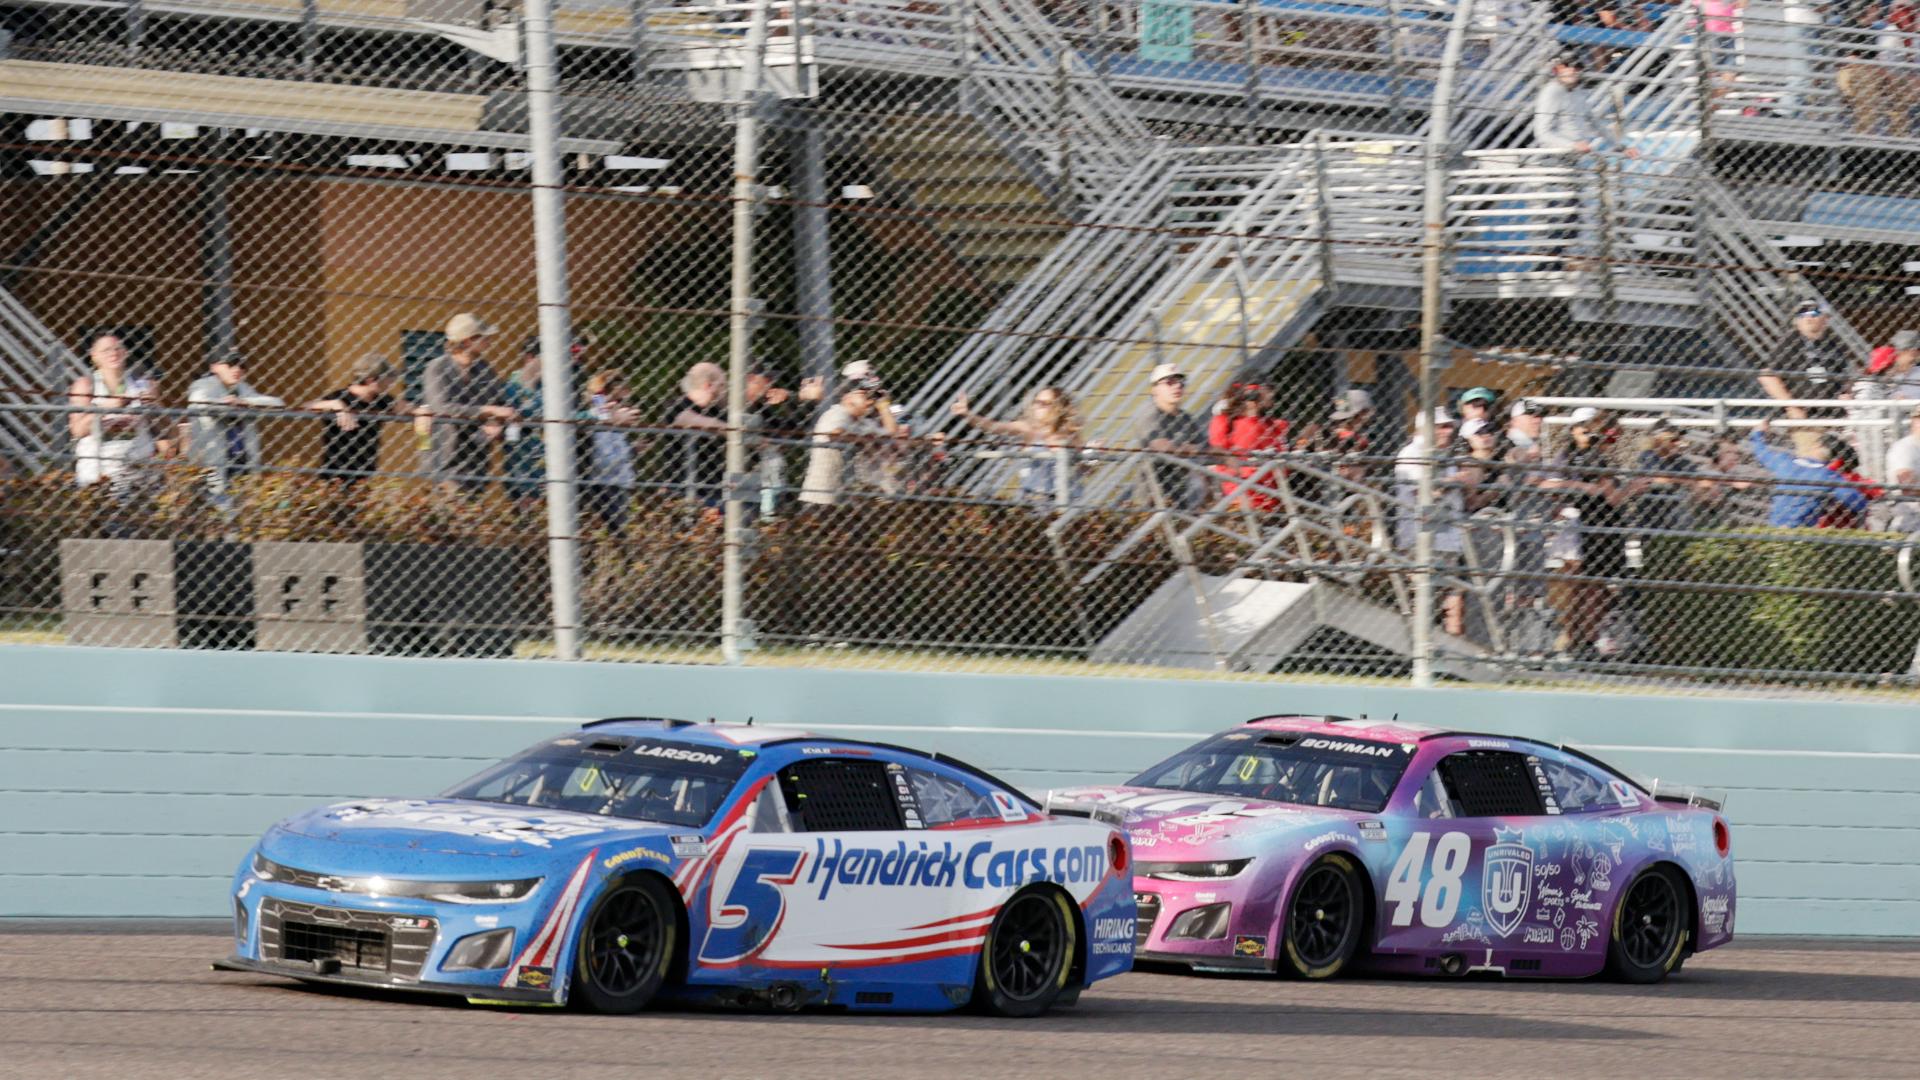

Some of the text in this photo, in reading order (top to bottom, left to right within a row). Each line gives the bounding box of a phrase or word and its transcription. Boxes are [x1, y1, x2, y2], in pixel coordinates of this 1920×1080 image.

[633, 745, 722, 765] LARSON
[1300, 738, 1394, 757] BOWMAN
[1488, 848, 1531, 861] UNRIVALED
[807, 838, 1105, 901] HendrickCars.com
[1384, 831, 1472, 928] 48
[1534, 863, 1561, 880] 50/50
[698, 845, 806, 963] 5
[1094, 918, 1134, 939] HIRING
